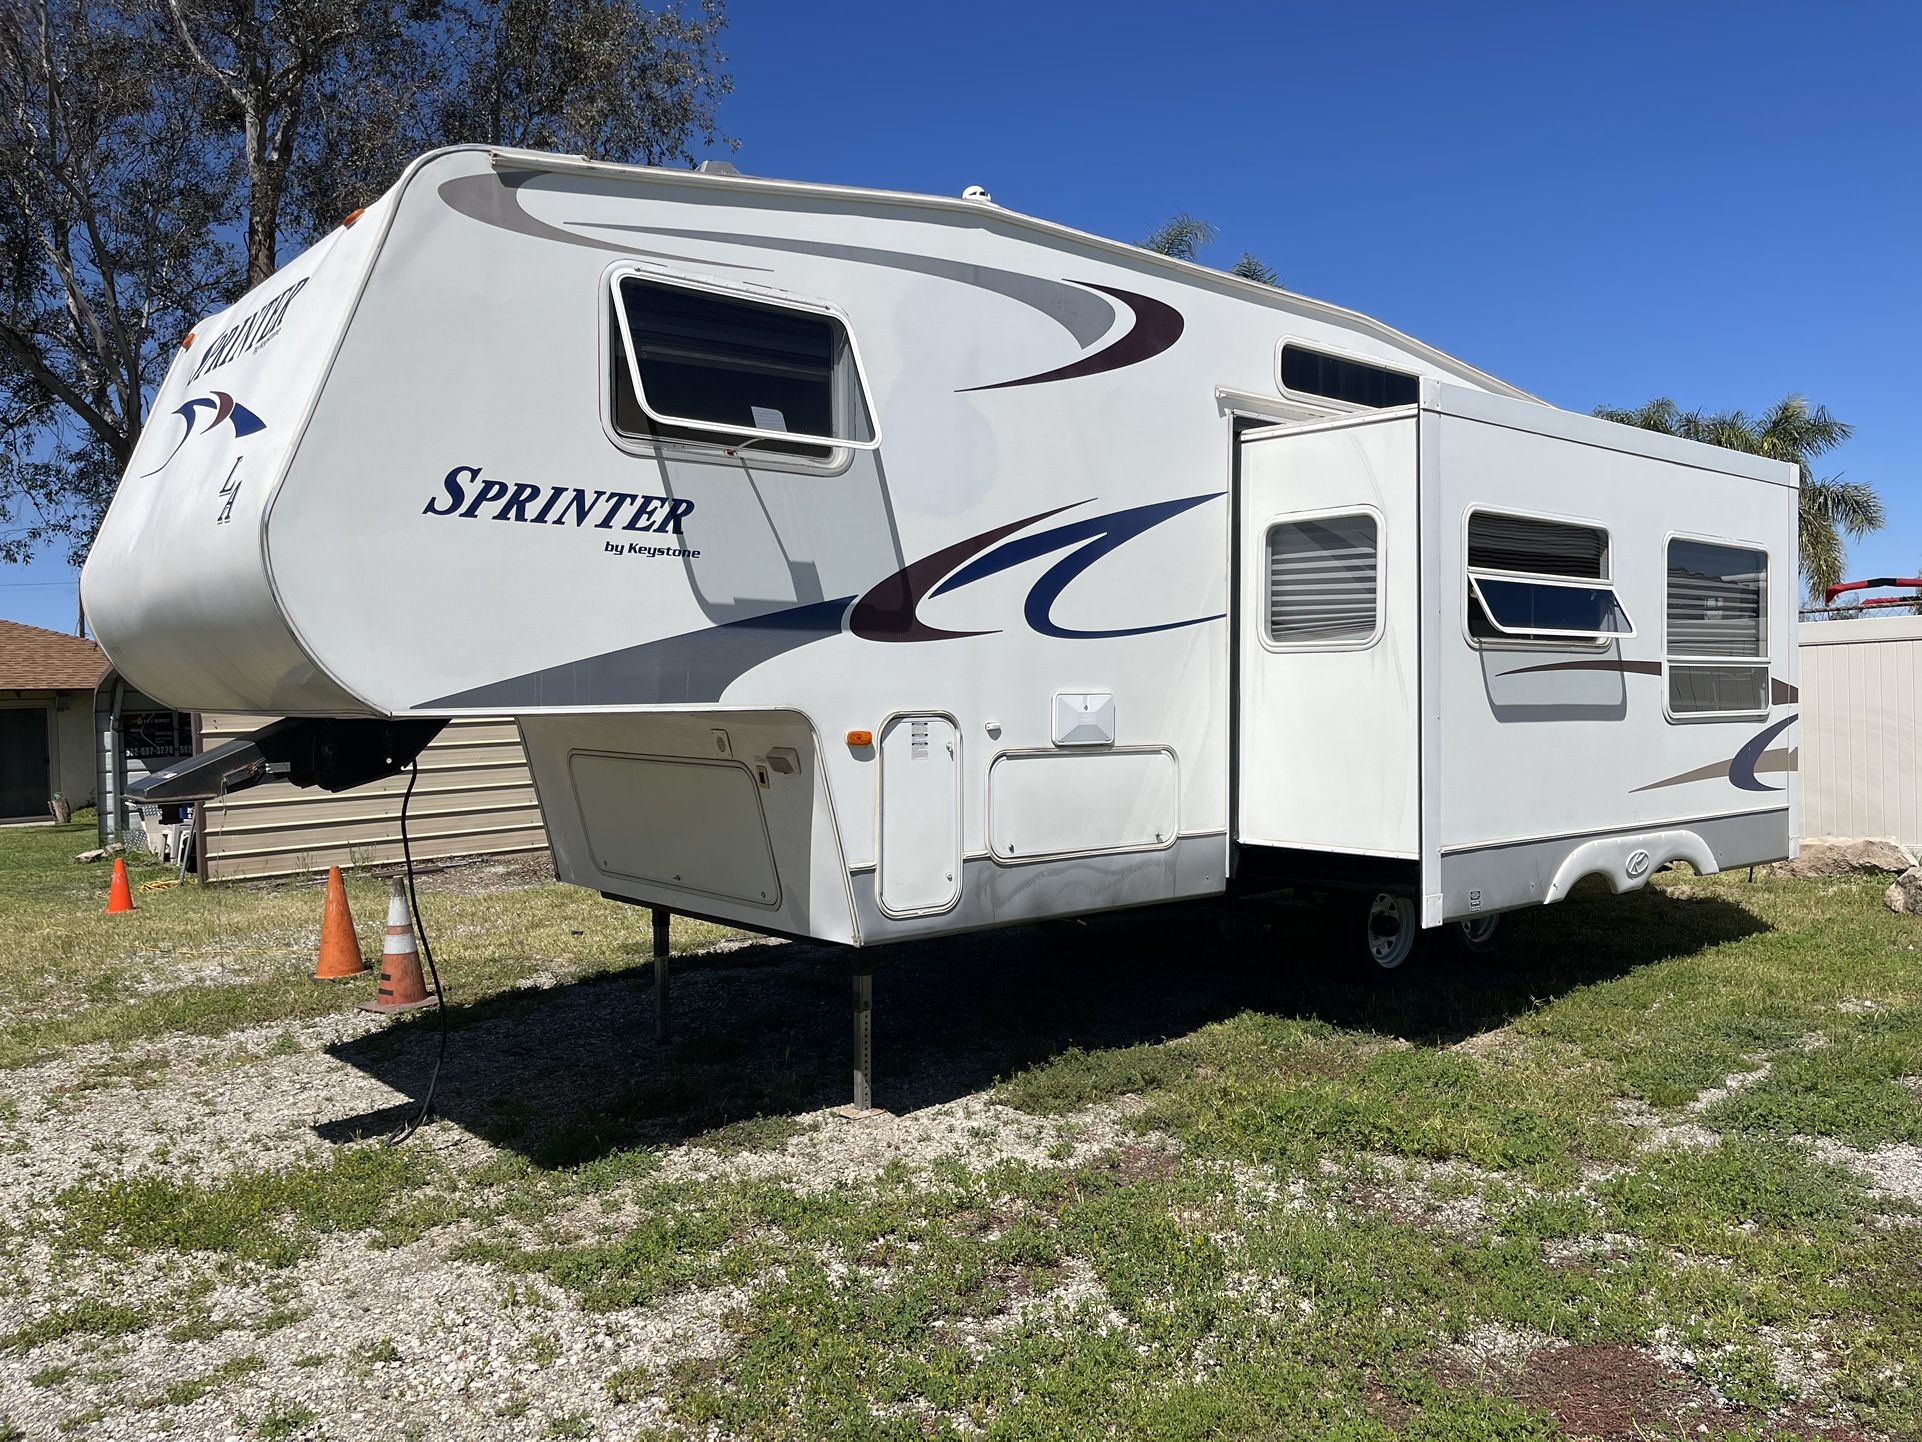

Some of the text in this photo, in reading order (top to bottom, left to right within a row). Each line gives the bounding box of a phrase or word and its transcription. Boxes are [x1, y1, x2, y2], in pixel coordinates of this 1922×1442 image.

[187, 276, 310, 387] SPRINTER
[422, 465, 695, 535] SPRINTER
[604, 541, 701, 559] by Keystone
